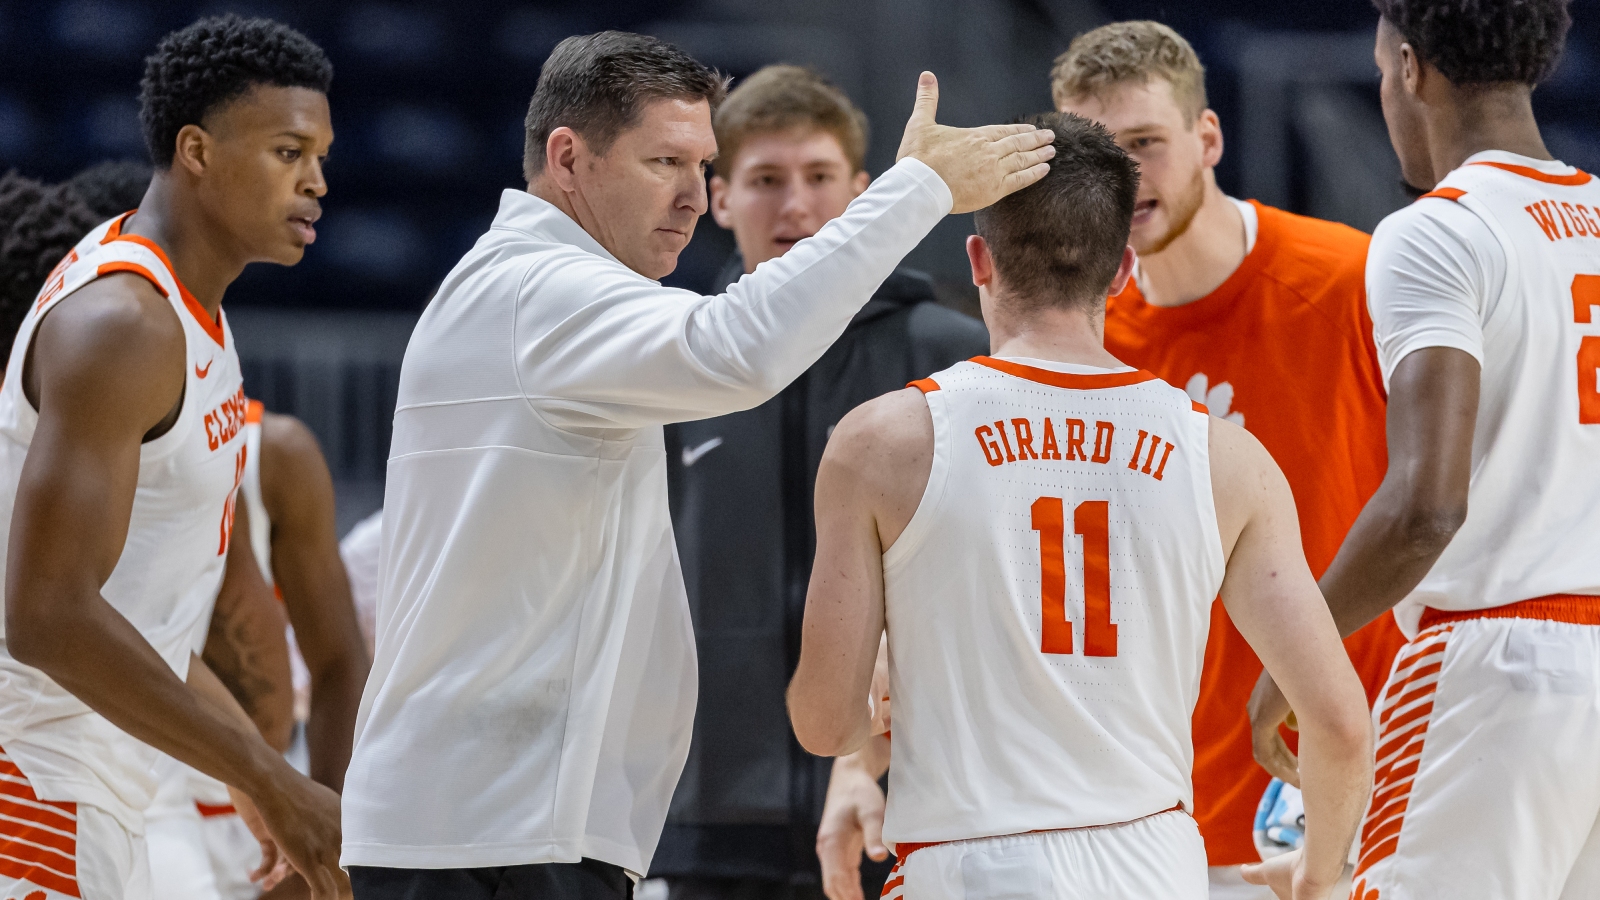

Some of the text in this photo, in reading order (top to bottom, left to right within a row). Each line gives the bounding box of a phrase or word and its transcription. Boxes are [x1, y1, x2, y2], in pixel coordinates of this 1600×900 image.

[1524, 199, 1600, 242] WIGG
[974, 417, 1175, 481] GIRARD III
[1030, 496, 1118, 658] 11
